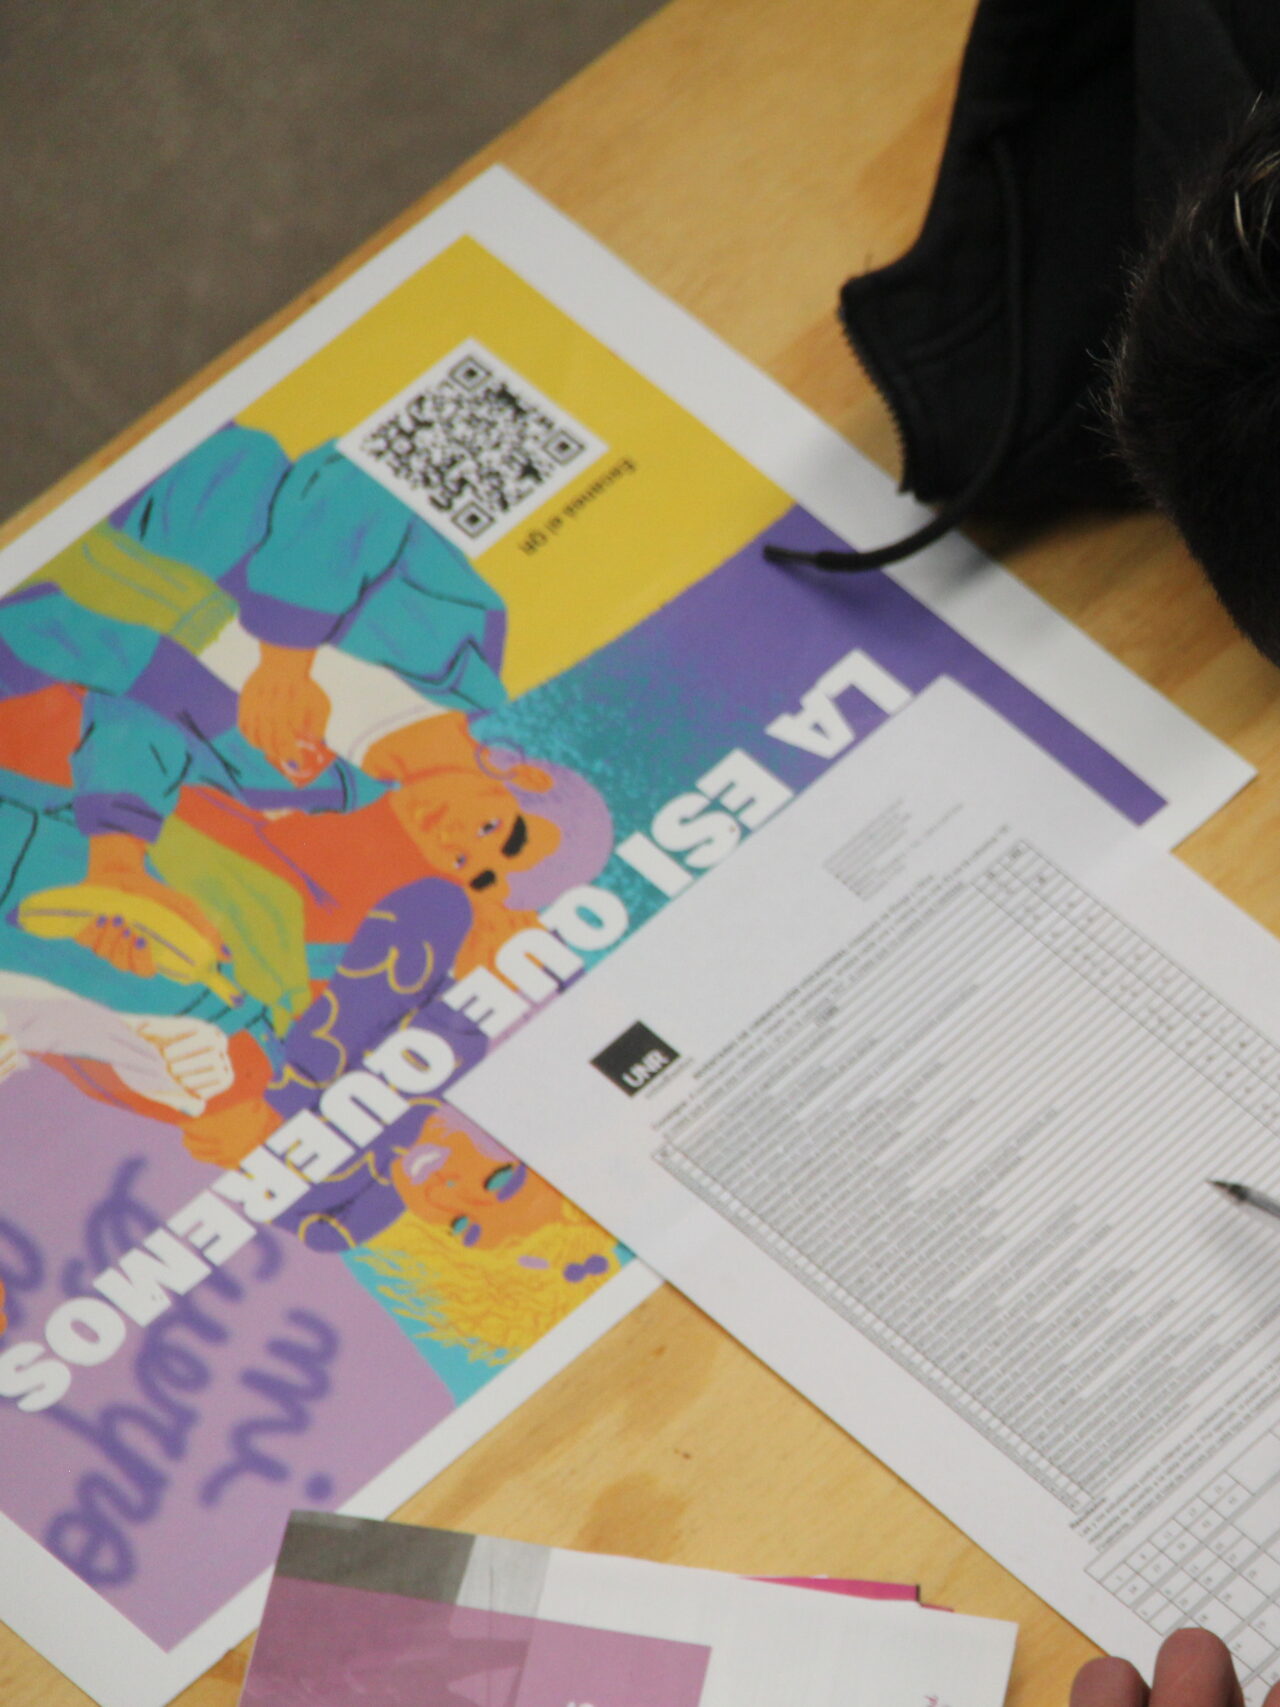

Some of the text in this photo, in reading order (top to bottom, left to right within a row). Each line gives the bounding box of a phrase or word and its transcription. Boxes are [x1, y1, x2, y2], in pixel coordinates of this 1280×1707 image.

[518, 530, 548, 556] QR
[765, 648, 915, 759] LA
[615, 748, 795, 900] ESI
[442, 884, 629, 1038] QUE
[621, 1048, 669, 1088] UNR
[0, 1027, 456, 1412] QUEREMOS
[200, 1308, 339, 1508] mi
